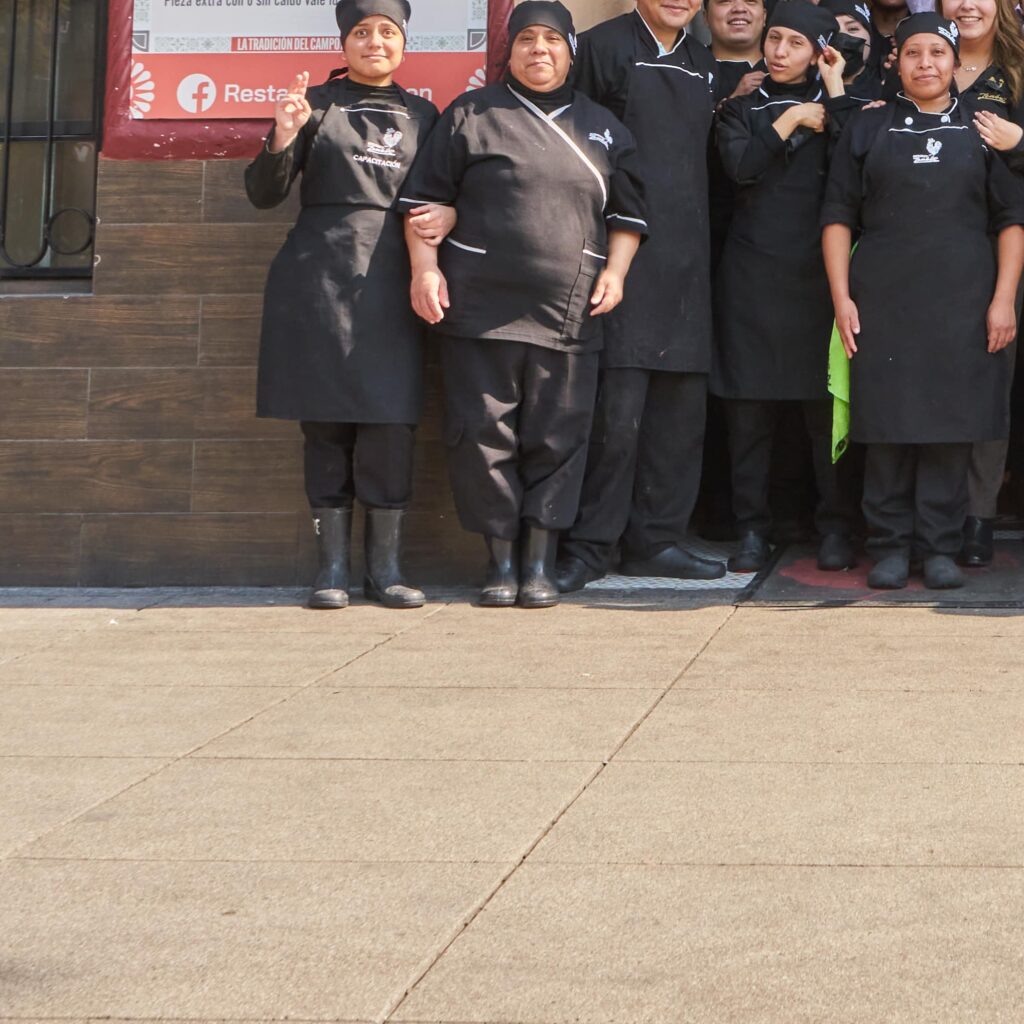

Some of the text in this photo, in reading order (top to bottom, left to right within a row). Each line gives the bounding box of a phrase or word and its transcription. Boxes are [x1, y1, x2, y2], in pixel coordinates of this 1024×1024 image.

[237, 36, 340, 51] LA TRADICIÓN DEL CAMPO
